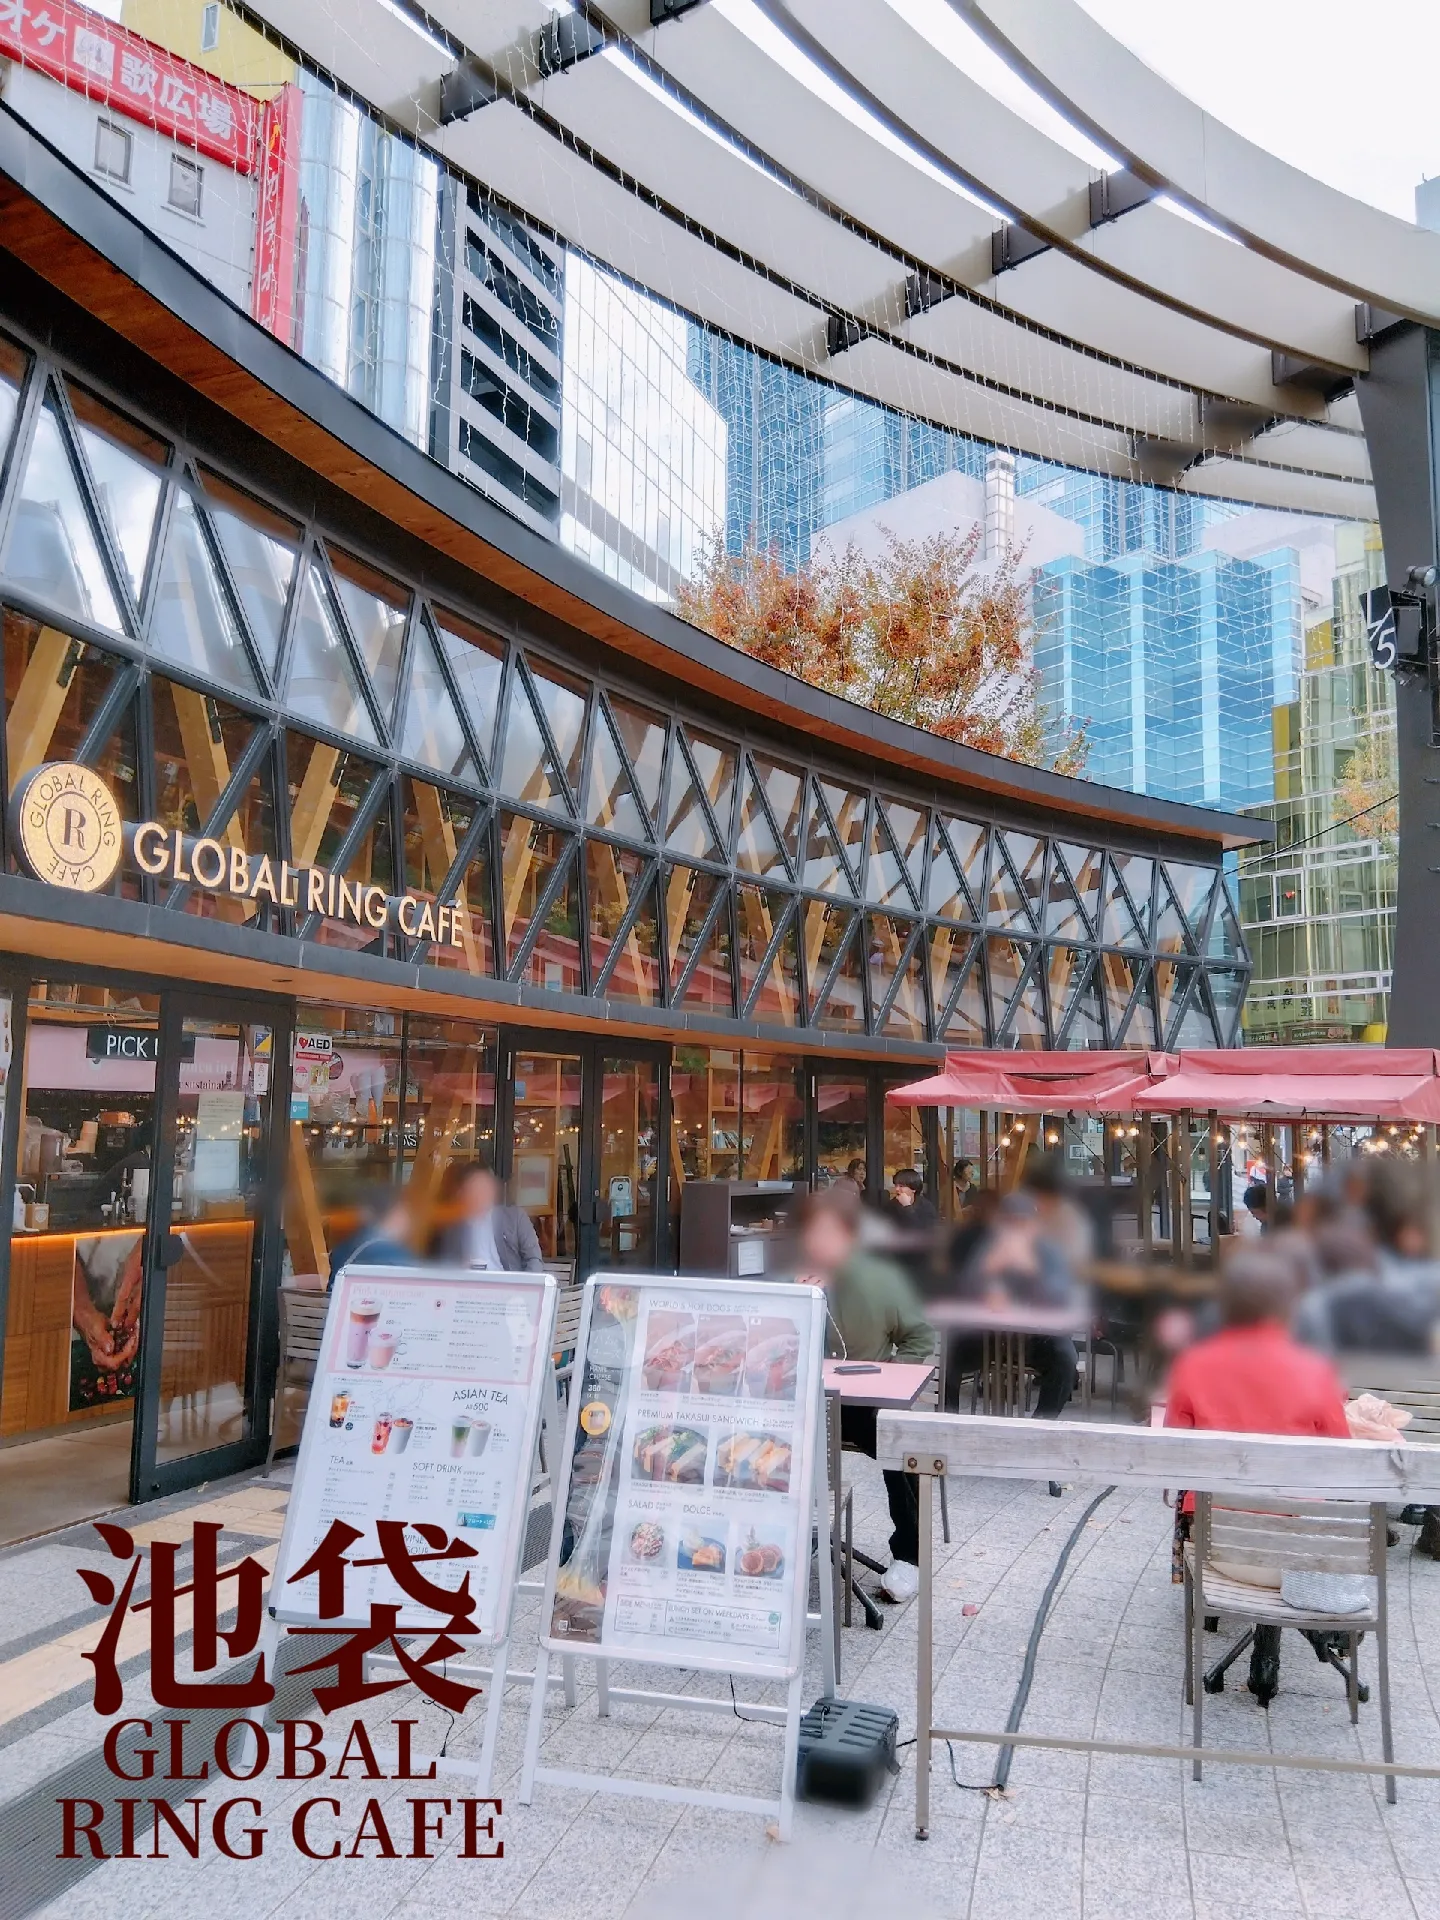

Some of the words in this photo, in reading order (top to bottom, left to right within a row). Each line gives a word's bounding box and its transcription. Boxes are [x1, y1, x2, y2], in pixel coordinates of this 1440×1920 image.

[120, 50, 232, 140] 歌広場
[30, 773, 85, 828] GLOBAL
[91, 788, 116, 847] RING
[61, 807, 86, 851] R
[133, 822, 294, 906] GLOBAL
[308, 869, 388, 928] RING
[398, 895, 464, 948] CAFÉ
[106, 1035, 149, 1058] PICK
[308, 1038, 331, 1050] AED
[452, 1388, 488, 1402] ASIAN
[491, 1390, 509, 1405] TEA
[637, 1408, 673, 1419] PREMIUM
[712, 1414, 759, 1426] SANDWICH
[412, 1462, 435, 1472] SOFT
[436, 1463, 462, 1474] DRINK
[628, 1499, 653, 1509] SALAD
[683, 1504, 710, 1515] DOLCE
